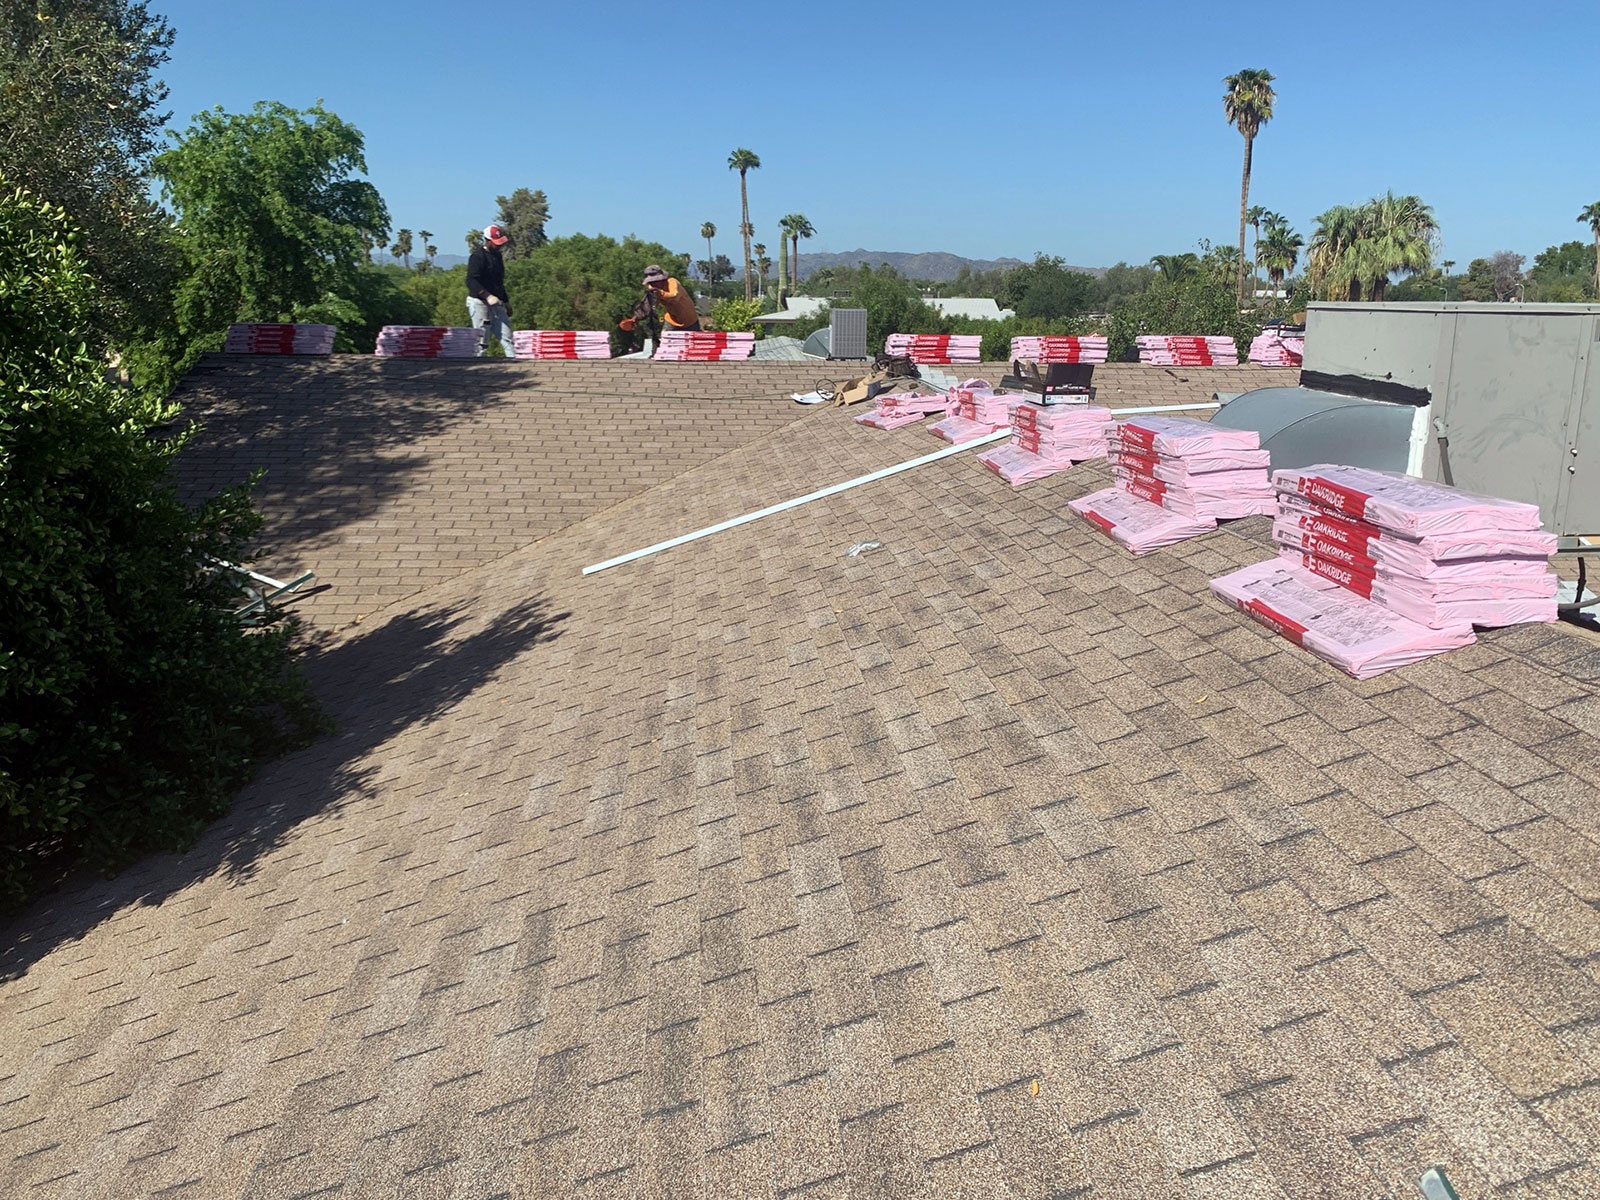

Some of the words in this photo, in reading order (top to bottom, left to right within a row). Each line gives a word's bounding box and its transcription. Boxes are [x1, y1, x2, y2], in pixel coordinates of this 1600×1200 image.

[1311, 483, 1345, 509] OAKRIDGE
[1313, 521, 1348, 543] OAKRIDGE
[1317, 540, 1354, 565] OAKRIDGE
[1317, 560, 1352, 584] OAKRIDGE
